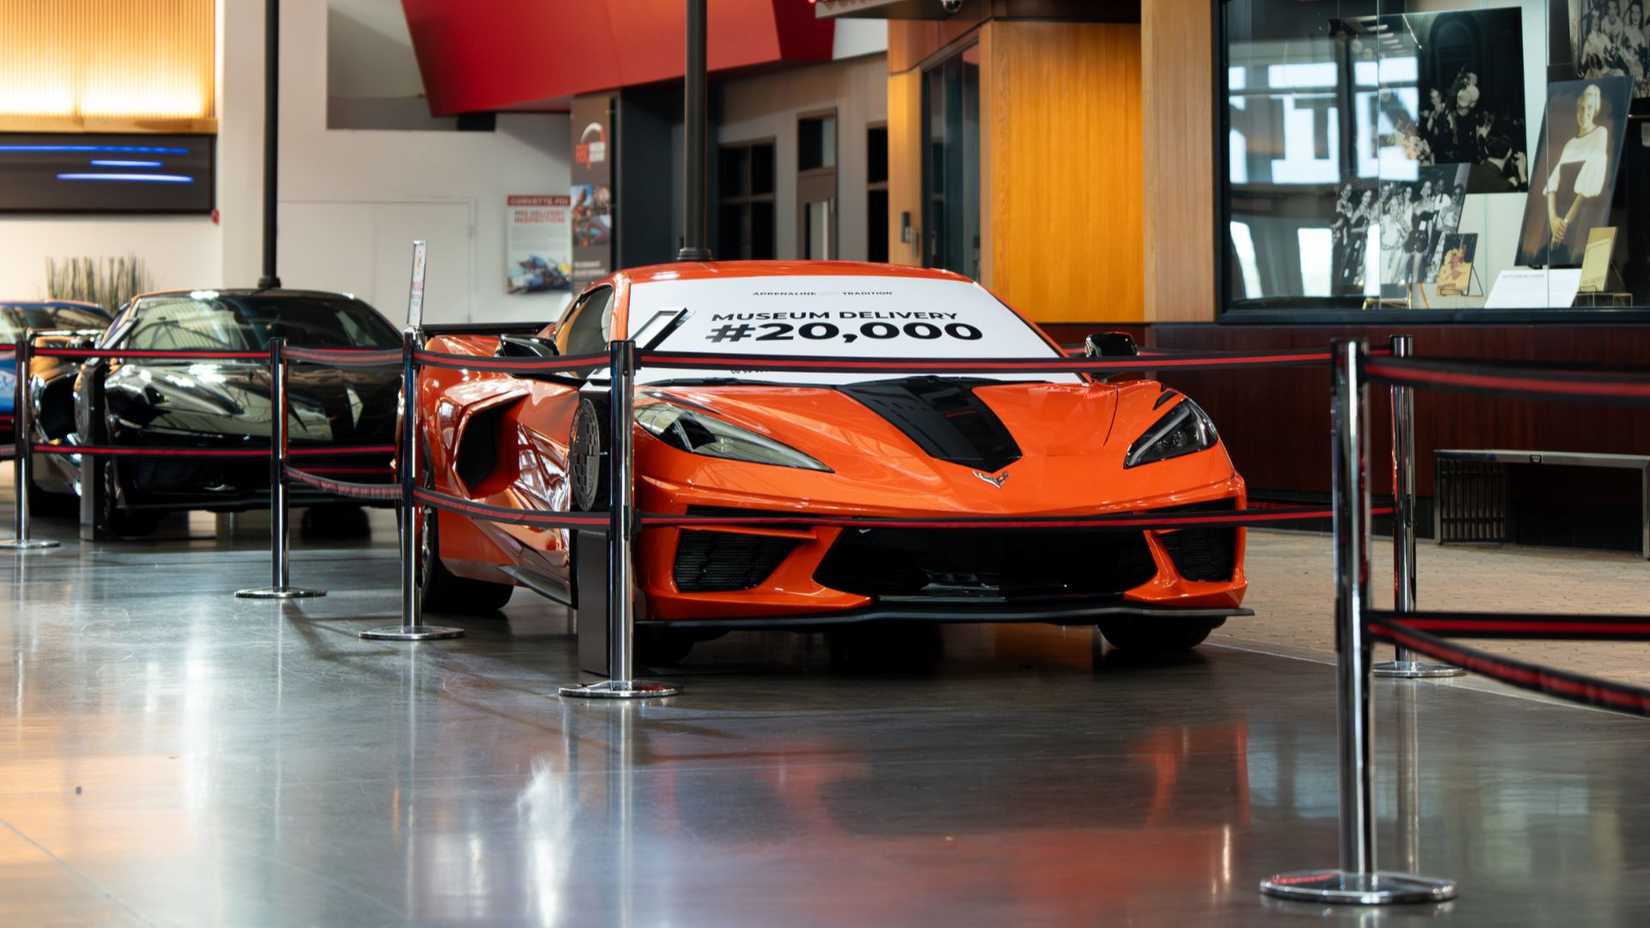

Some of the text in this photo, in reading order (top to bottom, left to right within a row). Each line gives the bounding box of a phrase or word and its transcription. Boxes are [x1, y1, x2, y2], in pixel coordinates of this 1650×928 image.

[711, 311, 957, 321] MUSEUM DELIVERY
[705, 322, 983, 343] #20,000
